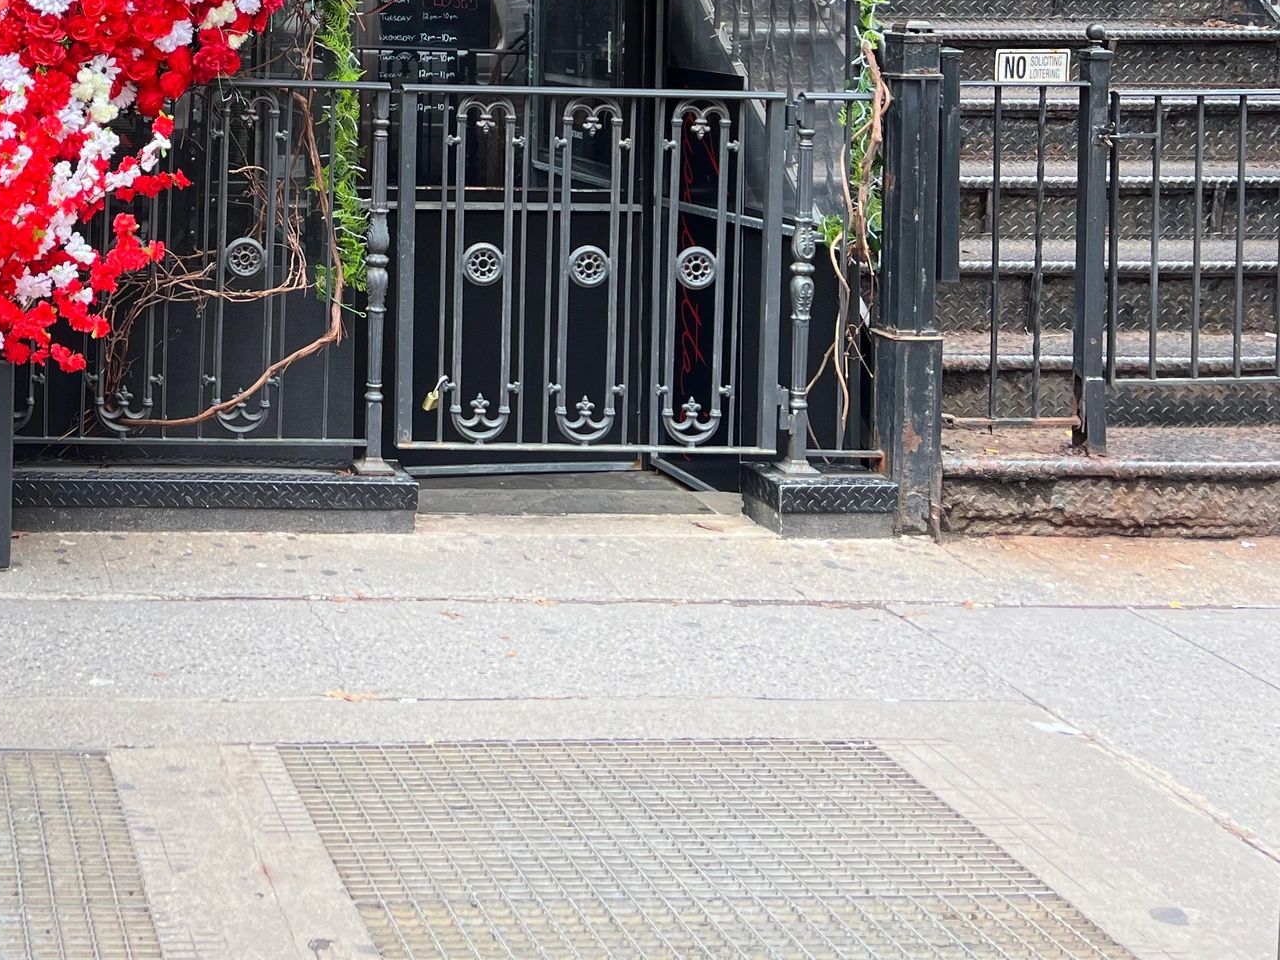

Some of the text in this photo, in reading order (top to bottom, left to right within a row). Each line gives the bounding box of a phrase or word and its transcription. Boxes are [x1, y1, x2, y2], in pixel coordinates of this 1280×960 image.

[1004, 55, 1027, 79] NO
[1030, 55, 1063, 67] SOLICITING
[1029, 68, 1060, 79] LOITERING
